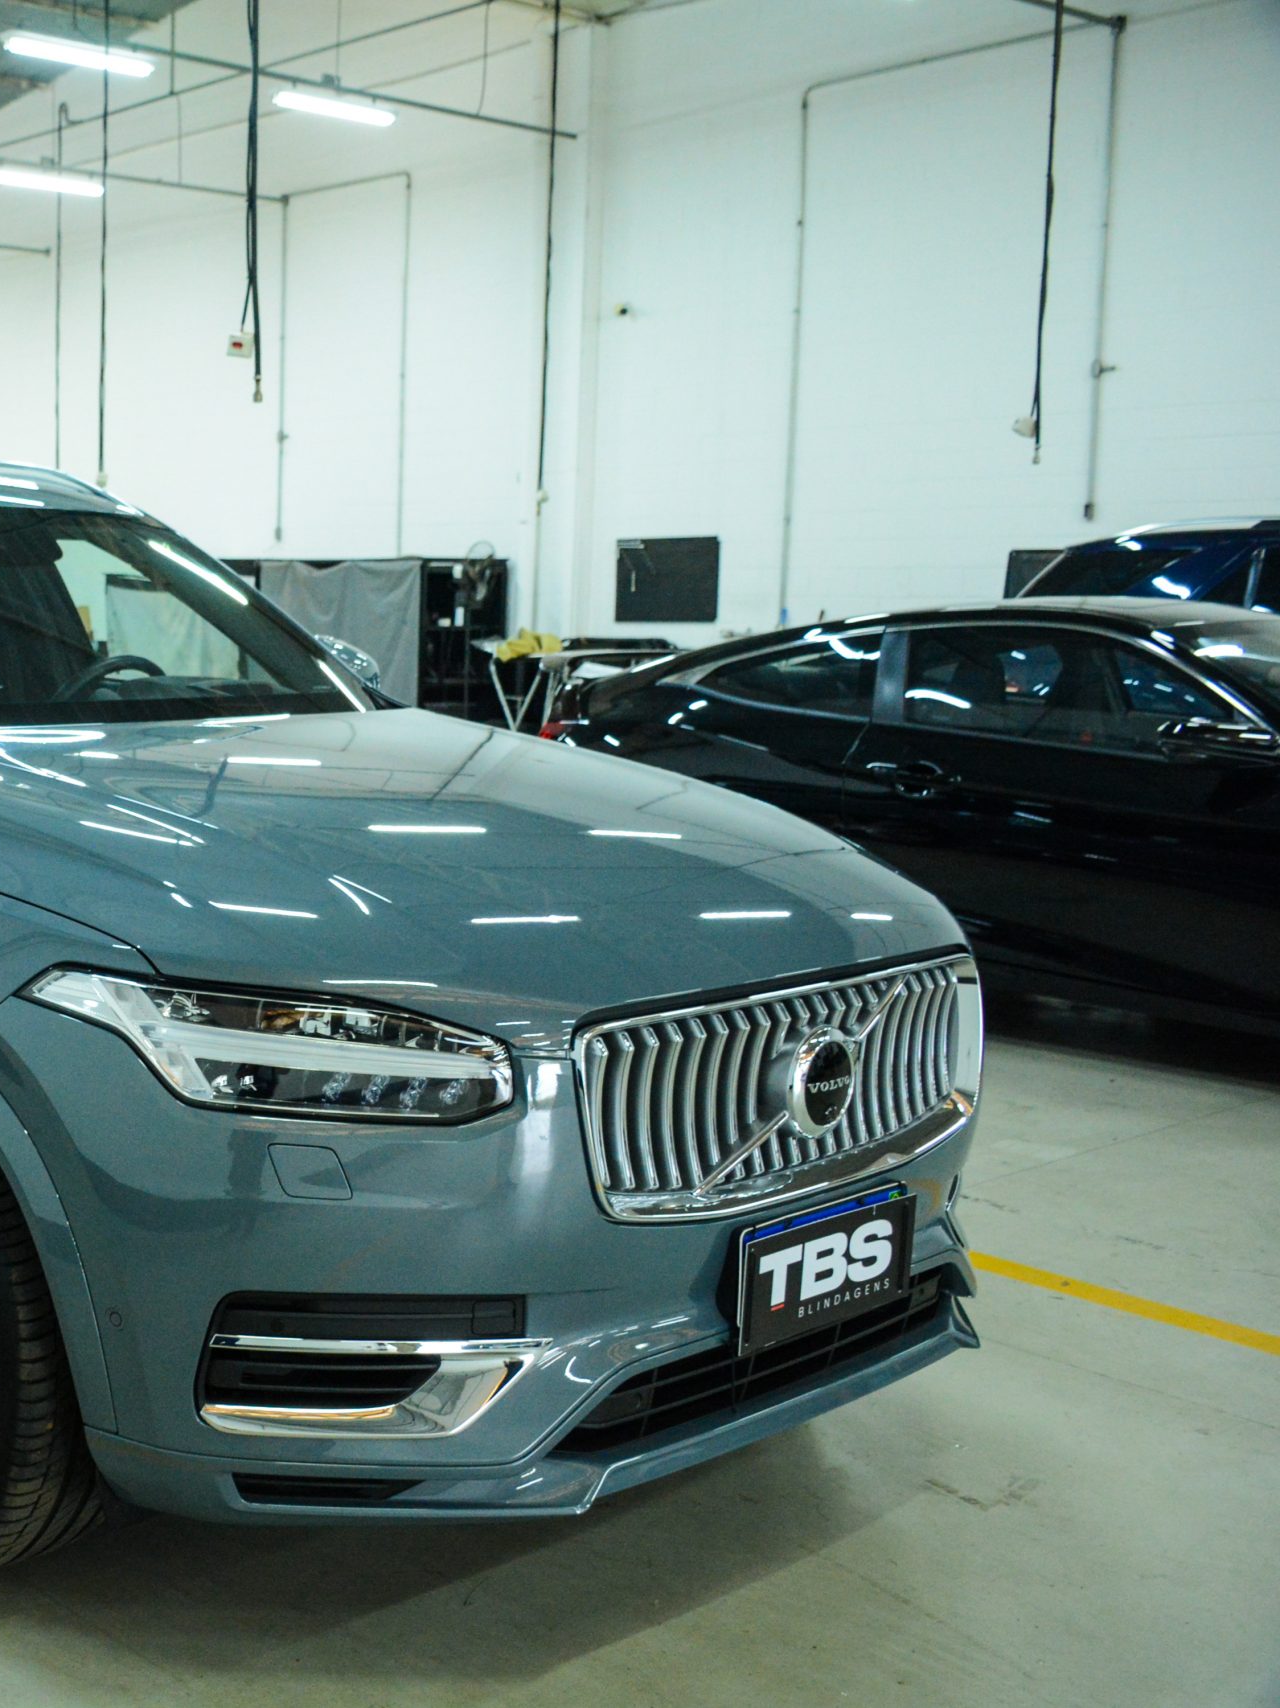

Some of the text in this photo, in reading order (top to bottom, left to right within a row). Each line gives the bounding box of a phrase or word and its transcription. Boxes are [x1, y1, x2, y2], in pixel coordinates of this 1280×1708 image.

[807, 1075, 851, 1094] VOLVO
[758, 1218, 893, 1307] TBS
[797, 1278, 891, 1318] BLINDAGENS
